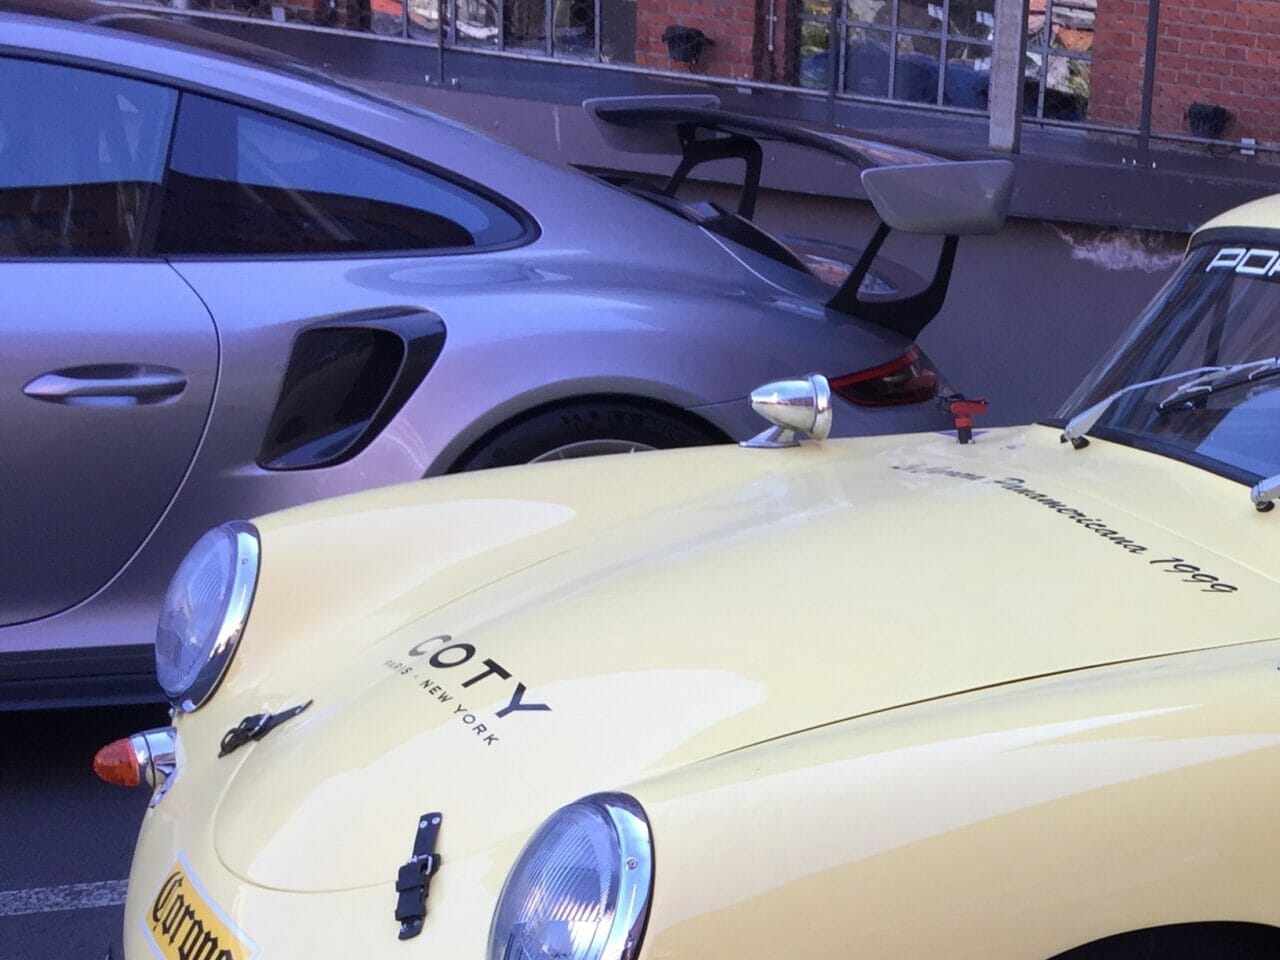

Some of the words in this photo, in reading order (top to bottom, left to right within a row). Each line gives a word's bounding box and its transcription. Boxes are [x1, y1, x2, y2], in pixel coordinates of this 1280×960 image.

[1150, 556, 1238, 593] 1999
[408, 634, 552, 719] COTY
[420, 679, 453, 703] NEW
[453, 704, 500, 746] YORK
